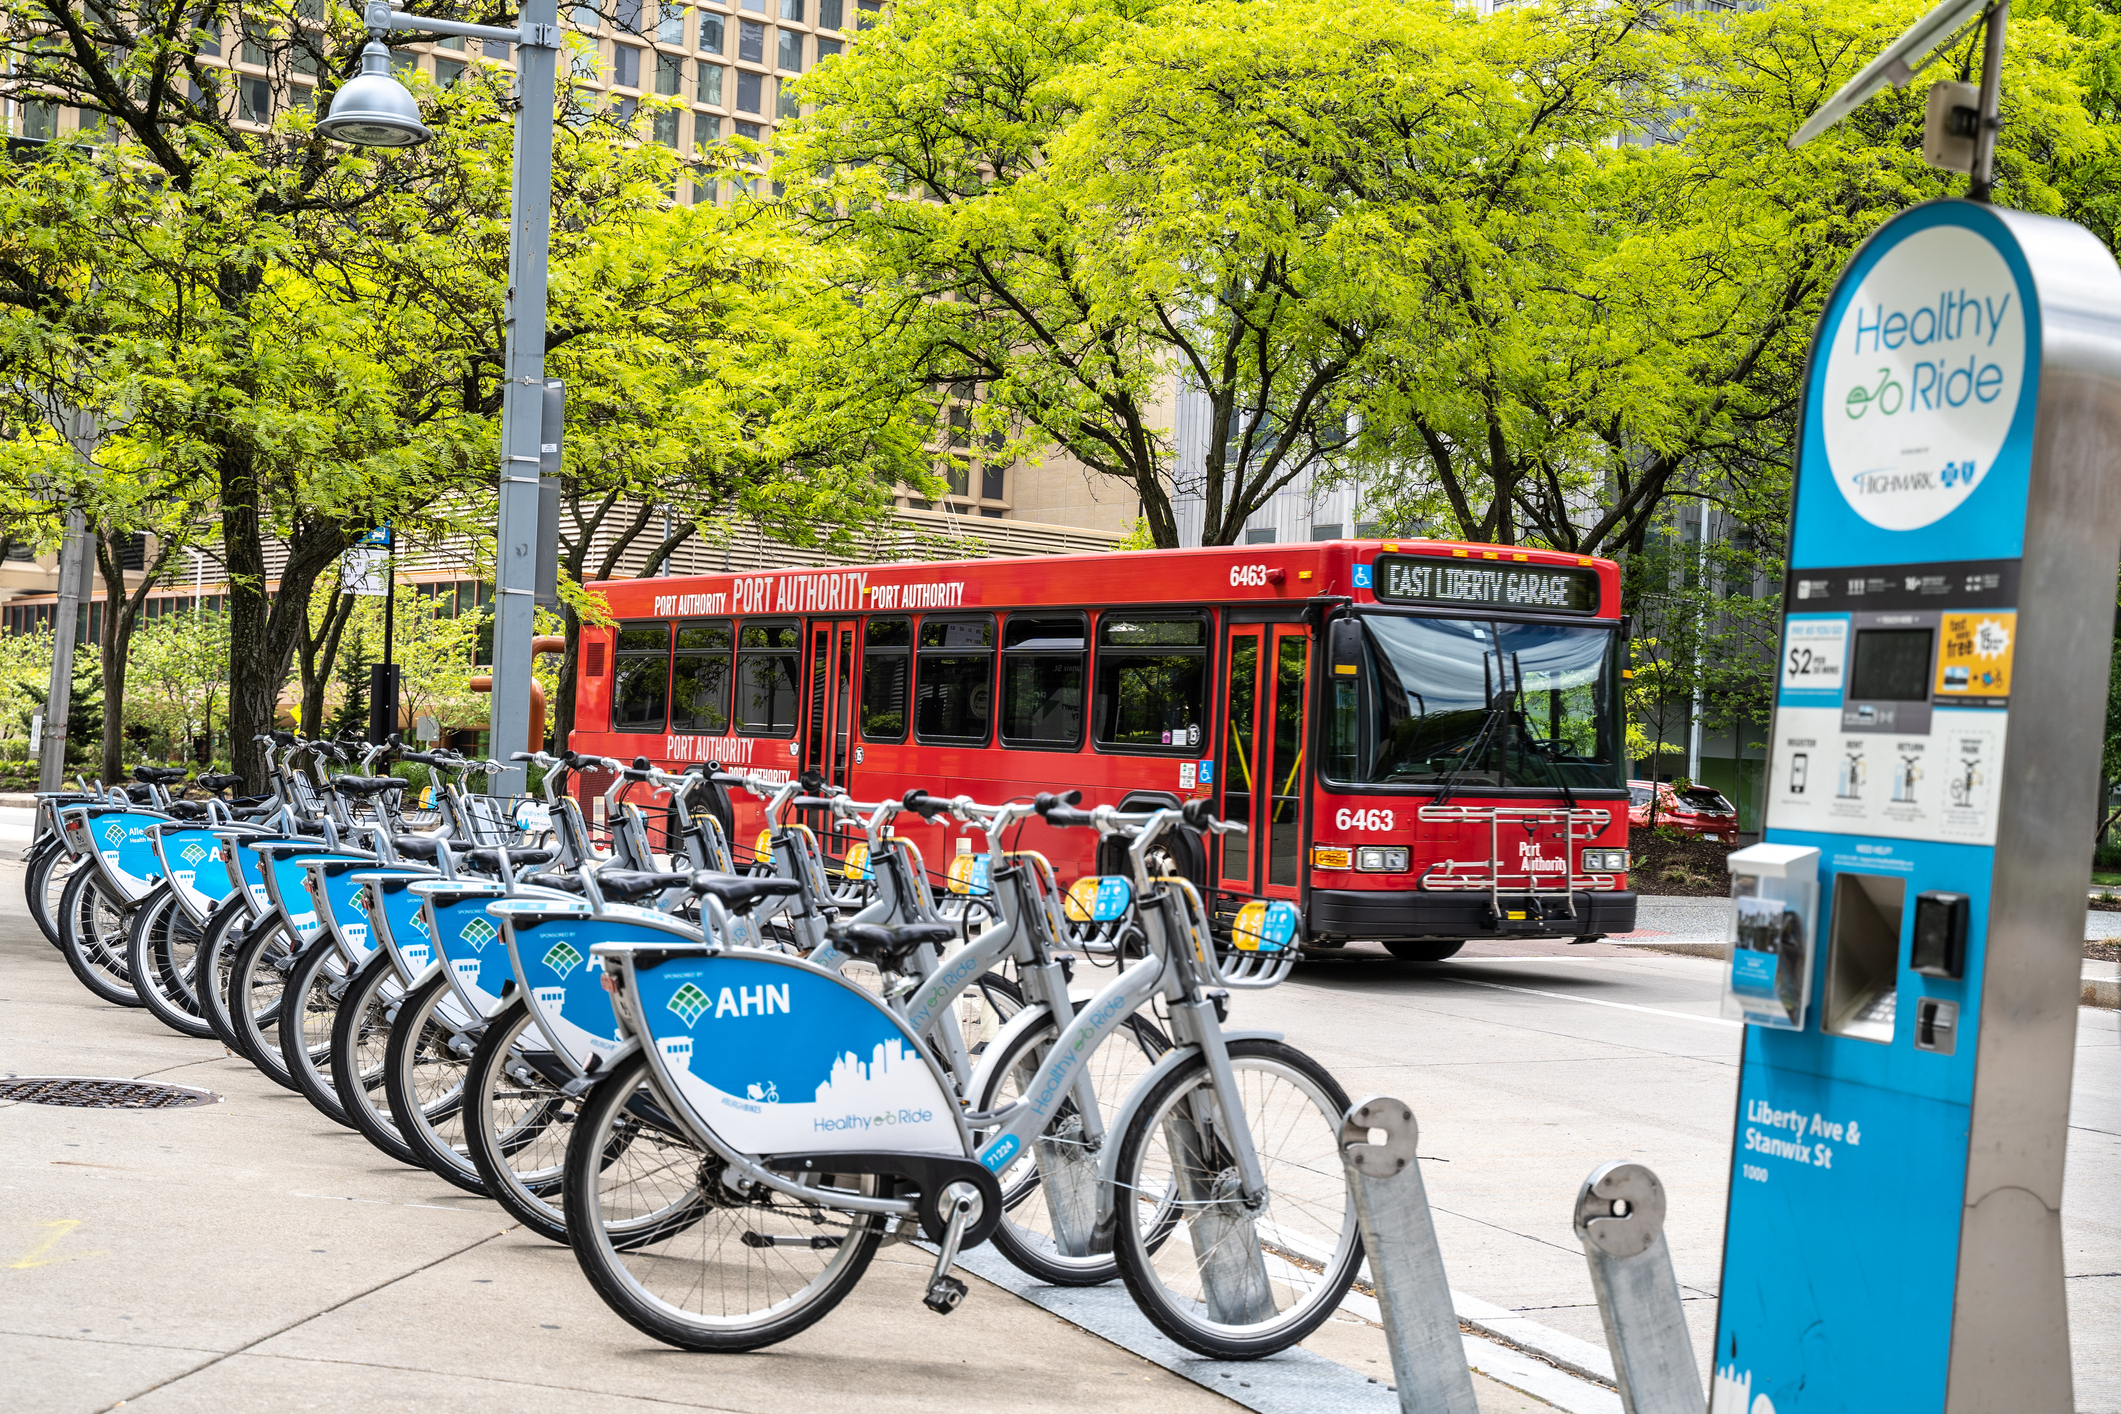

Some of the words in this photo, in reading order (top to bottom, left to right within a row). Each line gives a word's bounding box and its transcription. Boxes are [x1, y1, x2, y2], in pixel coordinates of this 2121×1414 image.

[1855, 288, 2012, 355] Healthy
[1910, 355, 2003, 412] Ride
[1857, 471, 1936, 495] HIGHMARK
[1230, 564, 1267, 586] 6463
[1389, 564, 1432, 597] EAST
[1436, 568, 1503, 601] LIBERTY
[1506, 573, 1569, 606] GARAGE
[654, 595, 677, 616] PORT
[678, 592, 727, 616] AUTHORITY
[732, 576, 773, 613] PORT
[775, 572, 868, 612] AUTHORITY
[870, 584, 900, 609] PORT
[902, 582, 965, 608] AUTHORITY
[1788, 648, 1813, 679] $2
[667, 735, 694, 760] PORT
[695, 737, 755, 763] AUTHORITY
[1335, 808, 1394, 831] 6463
[1519, 841, 1542, 857] Port
[663, 972, 696, 980] SPONSORED
[942, 956, 978, 989] Ride
[715, 983, 790, 1018] AHN
[1031, 1049, 1078, 1116] Healthy
[1089, 995, 1126, 1029] Ride
[813, 1113, 872, 1132] Healthy
[898, 1108, 933, 1125] Ride
[1747, 1099, 1808, 1139] Liberty
[1809, 1112, 1843, 1142] Ave
[1845, 1120, 1861, 1146] &
[986, 1140, 1014, 1166] 71224
[1744, 1127, 1811, 1164] Stanwix
[1813, 1143, 1833, 1169] St
[1742, 1163, 1769, 1183] 1000
